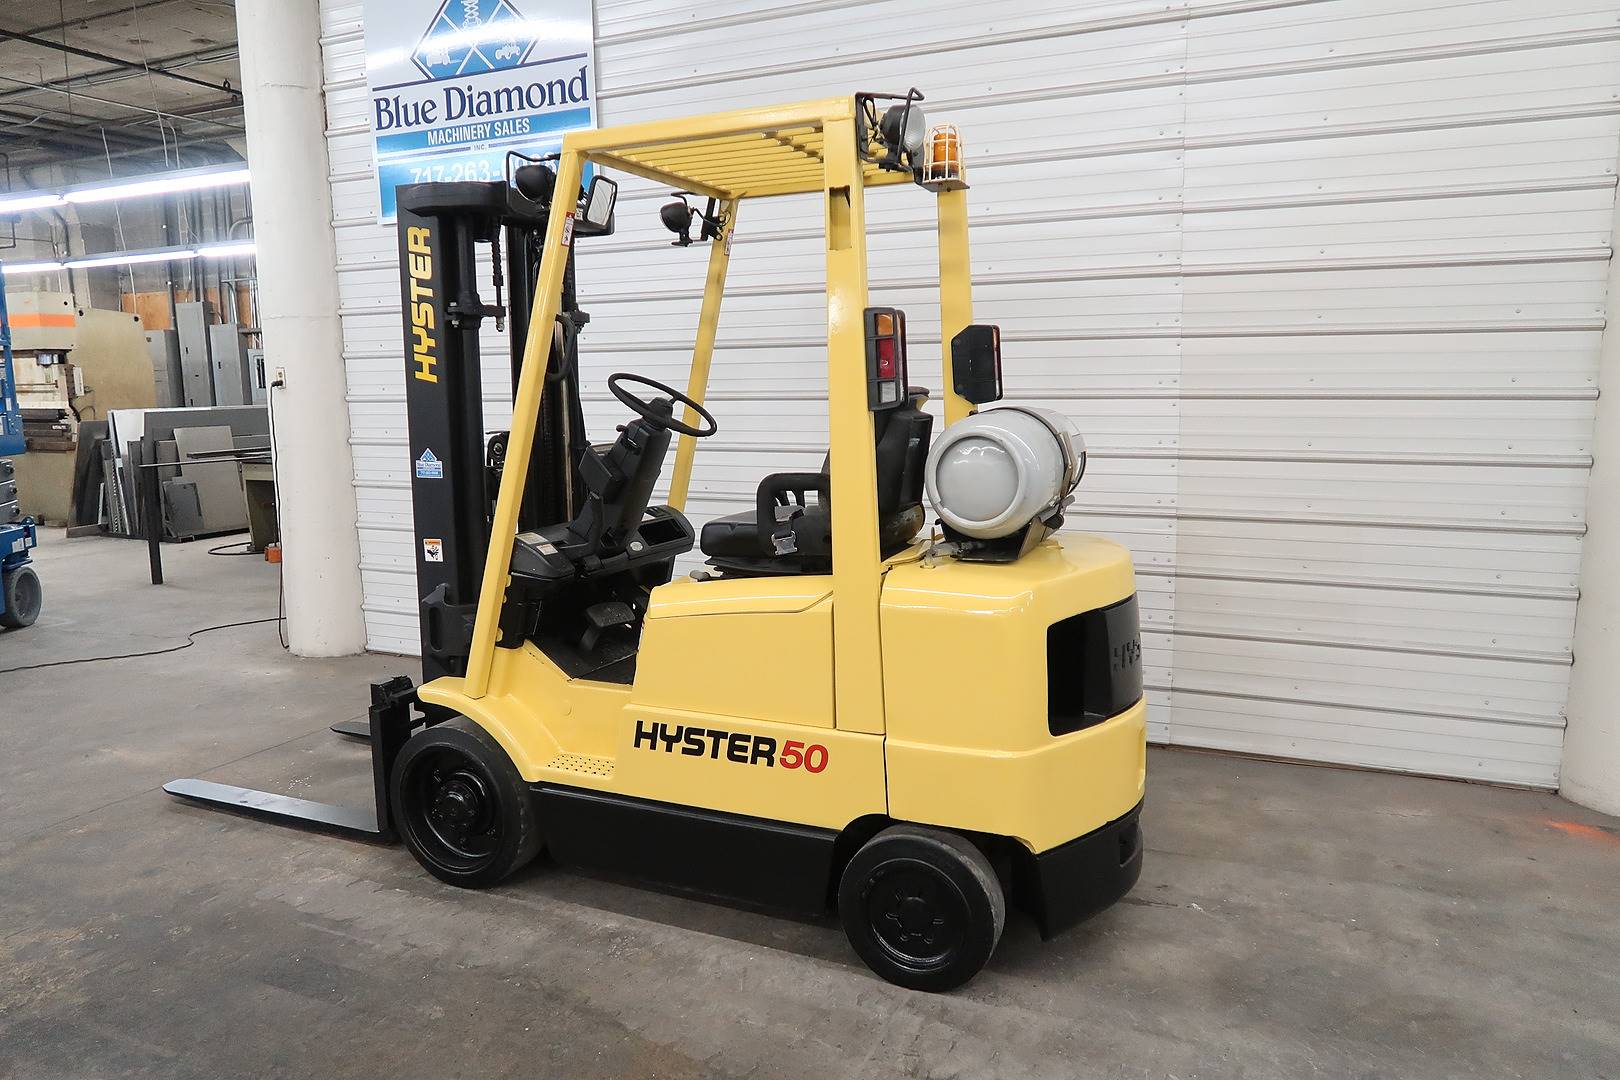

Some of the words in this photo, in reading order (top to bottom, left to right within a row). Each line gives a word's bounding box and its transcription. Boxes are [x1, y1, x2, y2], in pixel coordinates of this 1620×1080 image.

[374, 95, 437, 131] Blue
[443, 65, 589, 121] Diamond
[427, 123, 493, 146] MACHINERY
[494, 118, 530, 138] SALES
[407, 226, 438, 384] HYSTER
[633, 720, 777, 767] HYSTER
[779, 740, 829, 774] 50
